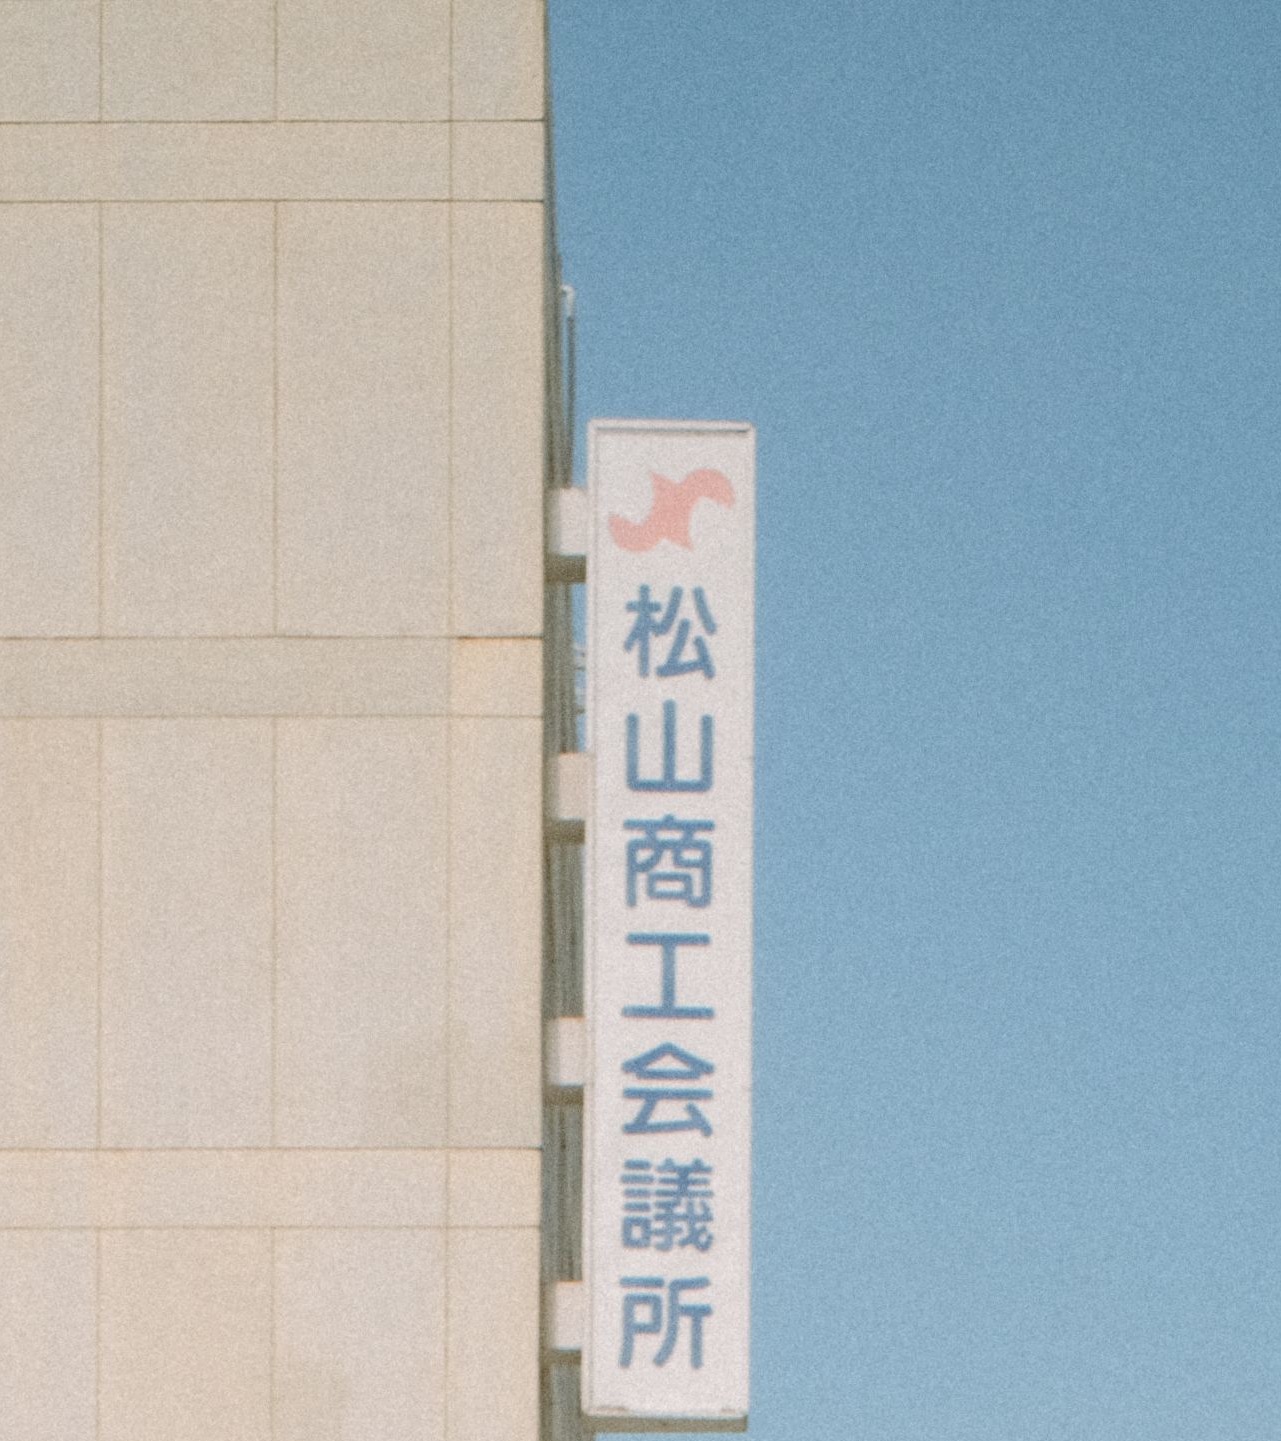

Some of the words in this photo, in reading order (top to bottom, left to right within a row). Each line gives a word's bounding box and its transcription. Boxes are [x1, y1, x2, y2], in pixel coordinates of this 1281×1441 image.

[619, 583, 718, 1371] 松山商工会議所
